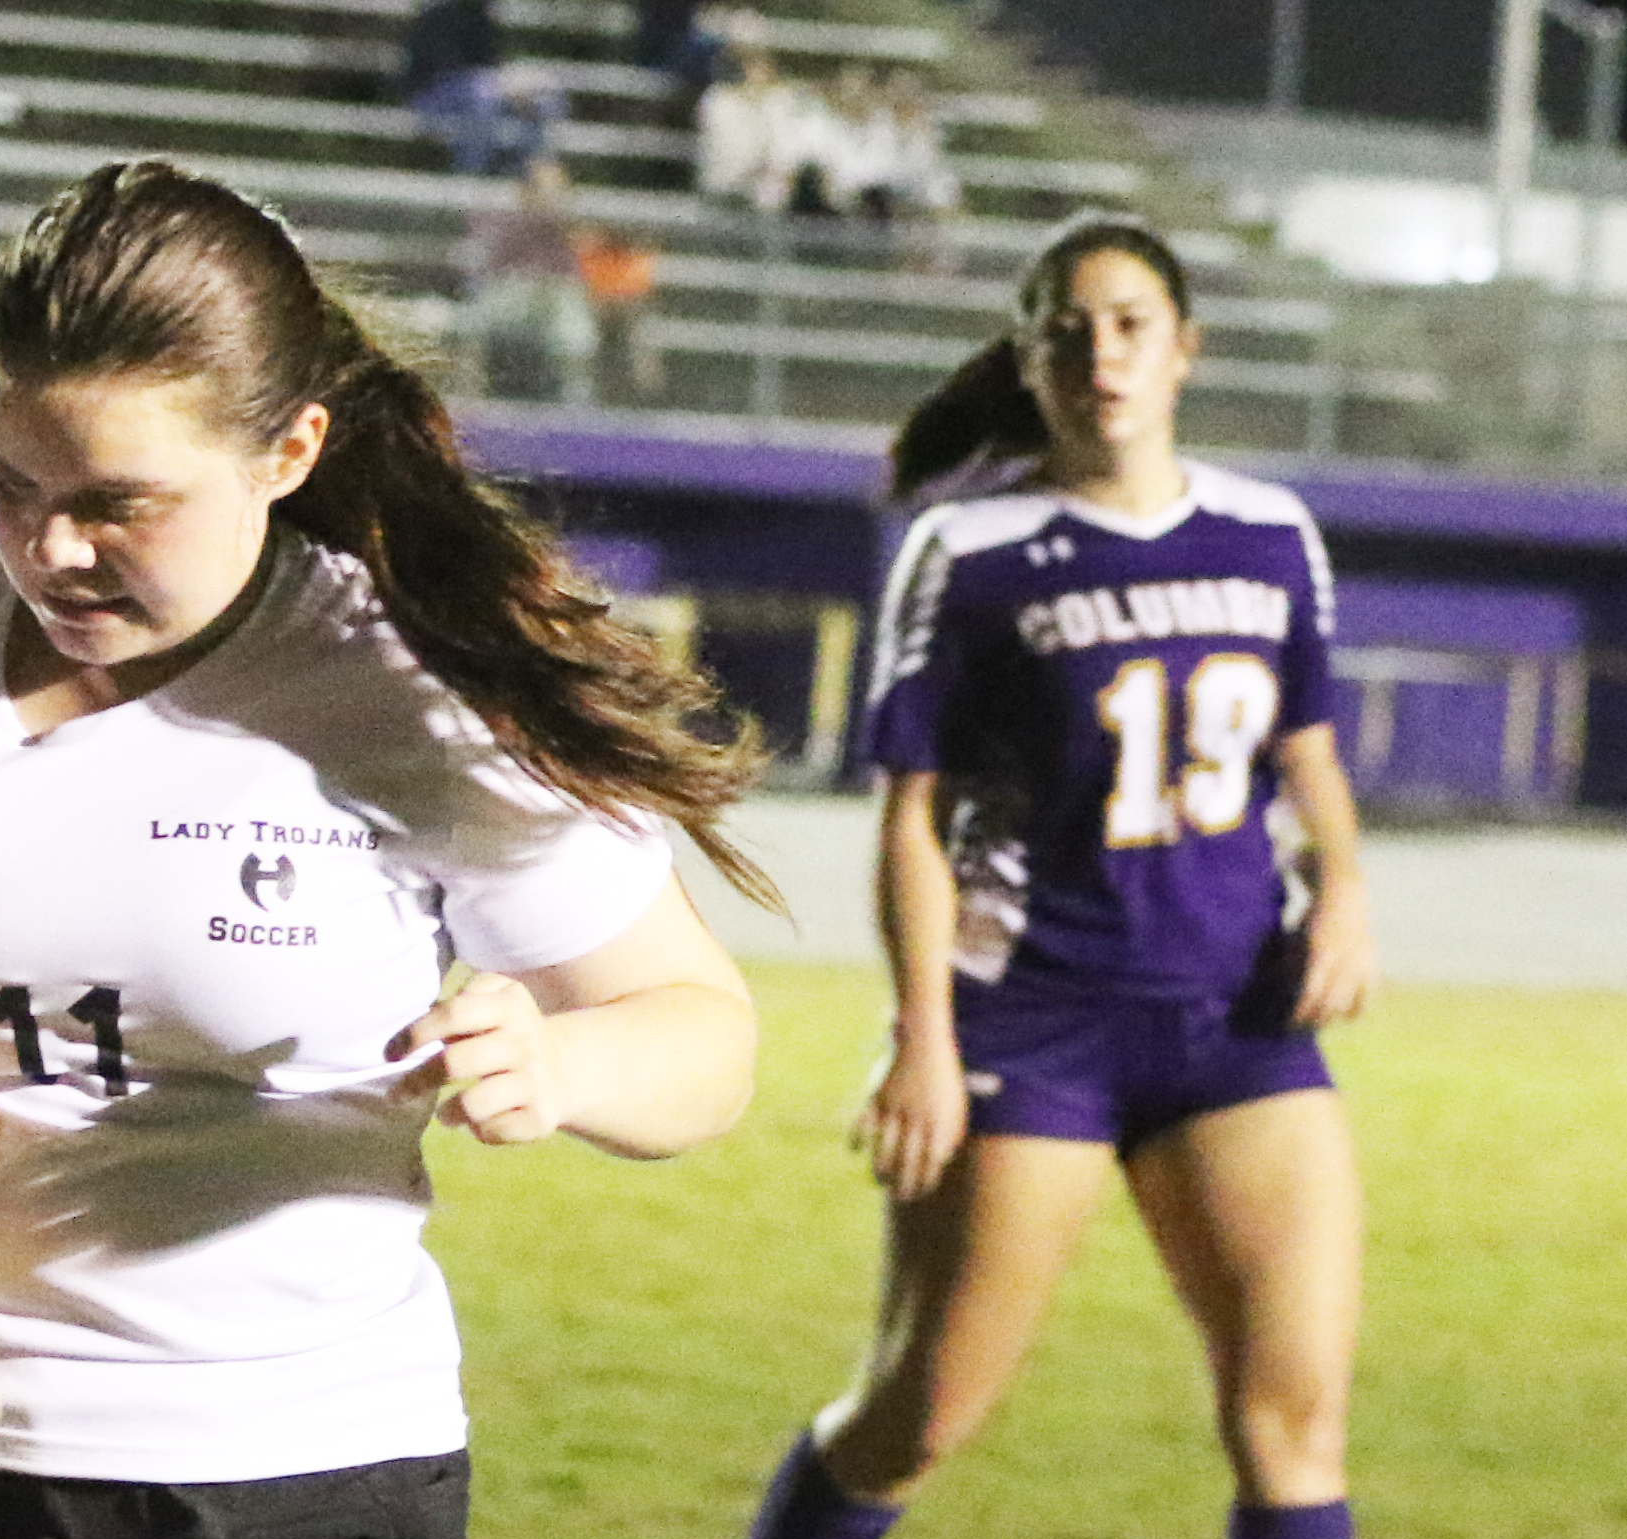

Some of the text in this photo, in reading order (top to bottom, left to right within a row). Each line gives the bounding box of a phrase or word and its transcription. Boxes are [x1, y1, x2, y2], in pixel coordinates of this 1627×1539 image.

[1096, 651, 1280, 846] 19
[150, 820, 379, 850] LADY TROJANS
[208, 916, 318, 946] SOCCER
